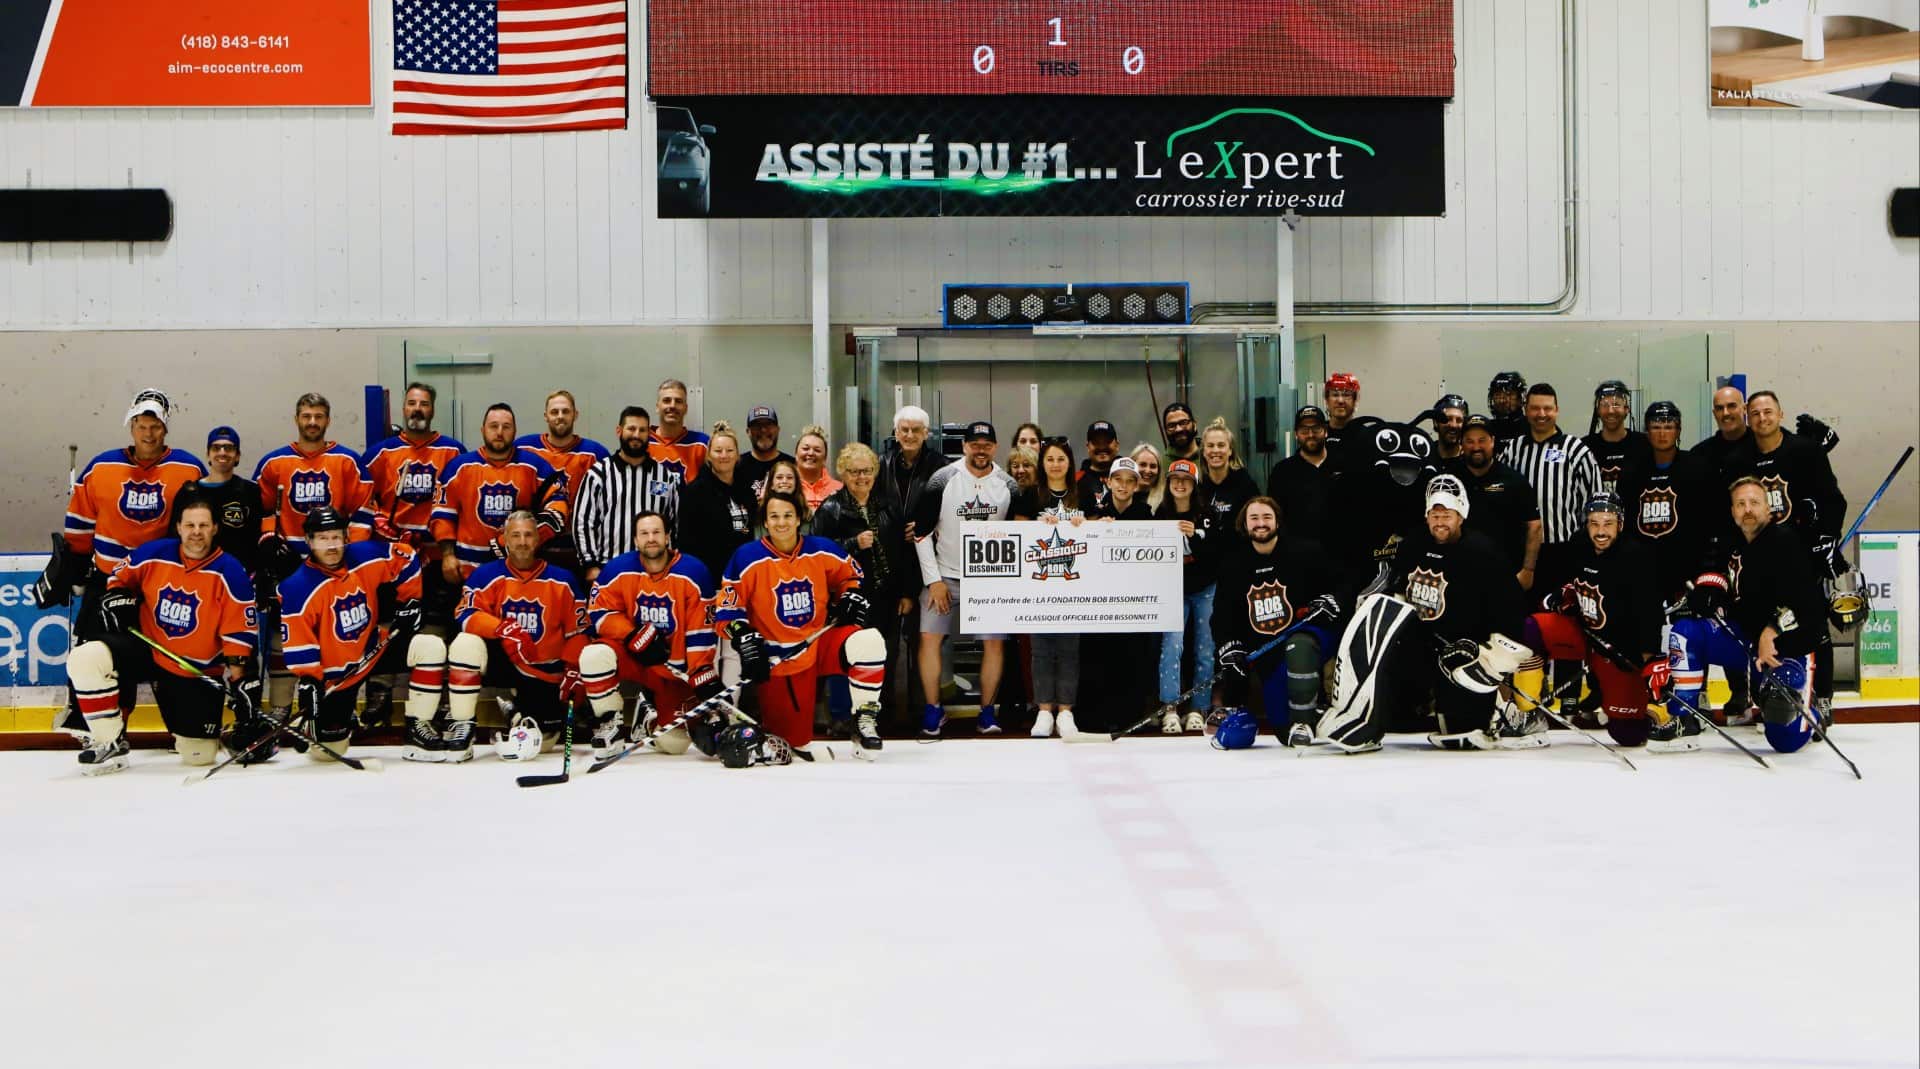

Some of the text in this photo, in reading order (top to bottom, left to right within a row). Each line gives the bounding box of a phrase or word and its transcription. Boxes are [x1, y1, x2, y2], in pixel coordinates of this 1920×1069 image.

[1048, 17, 1068, 46] 1
[181, 34, 289, 51] (418) 843-6141
[168, 60, 304, 74] aim-ecocentre.com
[973, 45, 1145, 76] 0 TIRS 0
[755, 134, 935, 181] ASSISTÉ
[948, 142, 1009, 180] DU
[1135, 190, 1345, 208] carrossier rive-sud
[295, 481, 325, 497] BOB
[404, 473, 433, 488] BOB
[127, 489, 158, 506] BOB
[485, 495, 513, 511] BOB
[1643, 501, 1670, 518] BOB
[968, 540, 1016, 564] BOB
[1025, 542, 1088, 563] CLASSIQUE
[1110, 548, 1131, 562] 190
[1136, 548, 1164, 562] 000
[968, 564, 1016, 574] BISSONNETTE
[1411, 581, 1439, 604] BOB
[1865, 582, 1891, 599] DE
[160, 598, 191, 622] BOB
[782, 591, 811, 612] BOB
[968, 597, 989, 606] Payez
[1254, 595, 1283, 617] BOB
[340, 602, 368, 628] BOB
[640, 605, 669, 624] BOB
[1608, 705, 1639, 714] CCM
